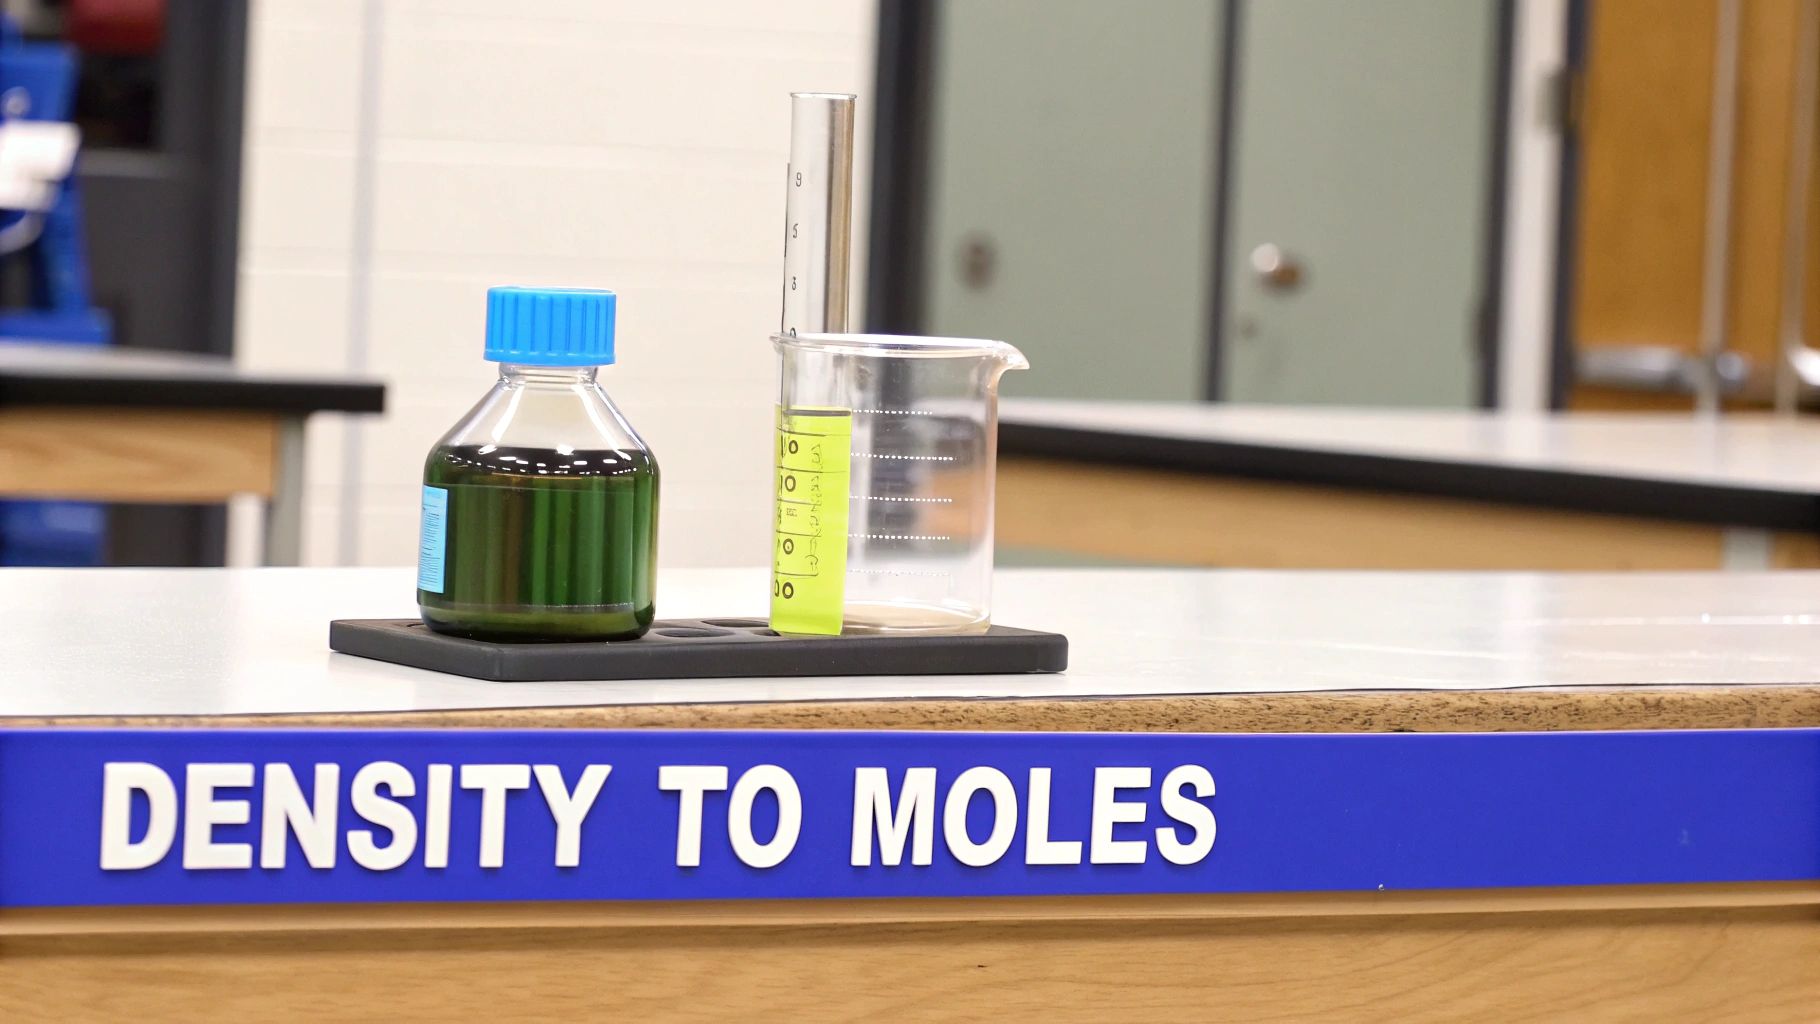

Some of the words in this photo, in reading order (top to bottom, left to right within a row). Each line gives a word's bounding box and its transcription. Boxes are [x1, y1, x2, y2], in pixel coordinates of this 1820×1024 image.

[100, 760, 613, 870] DENSITY
[658, 764, 802, 868] TO
[850, 764, 1217, 866] MOLES
